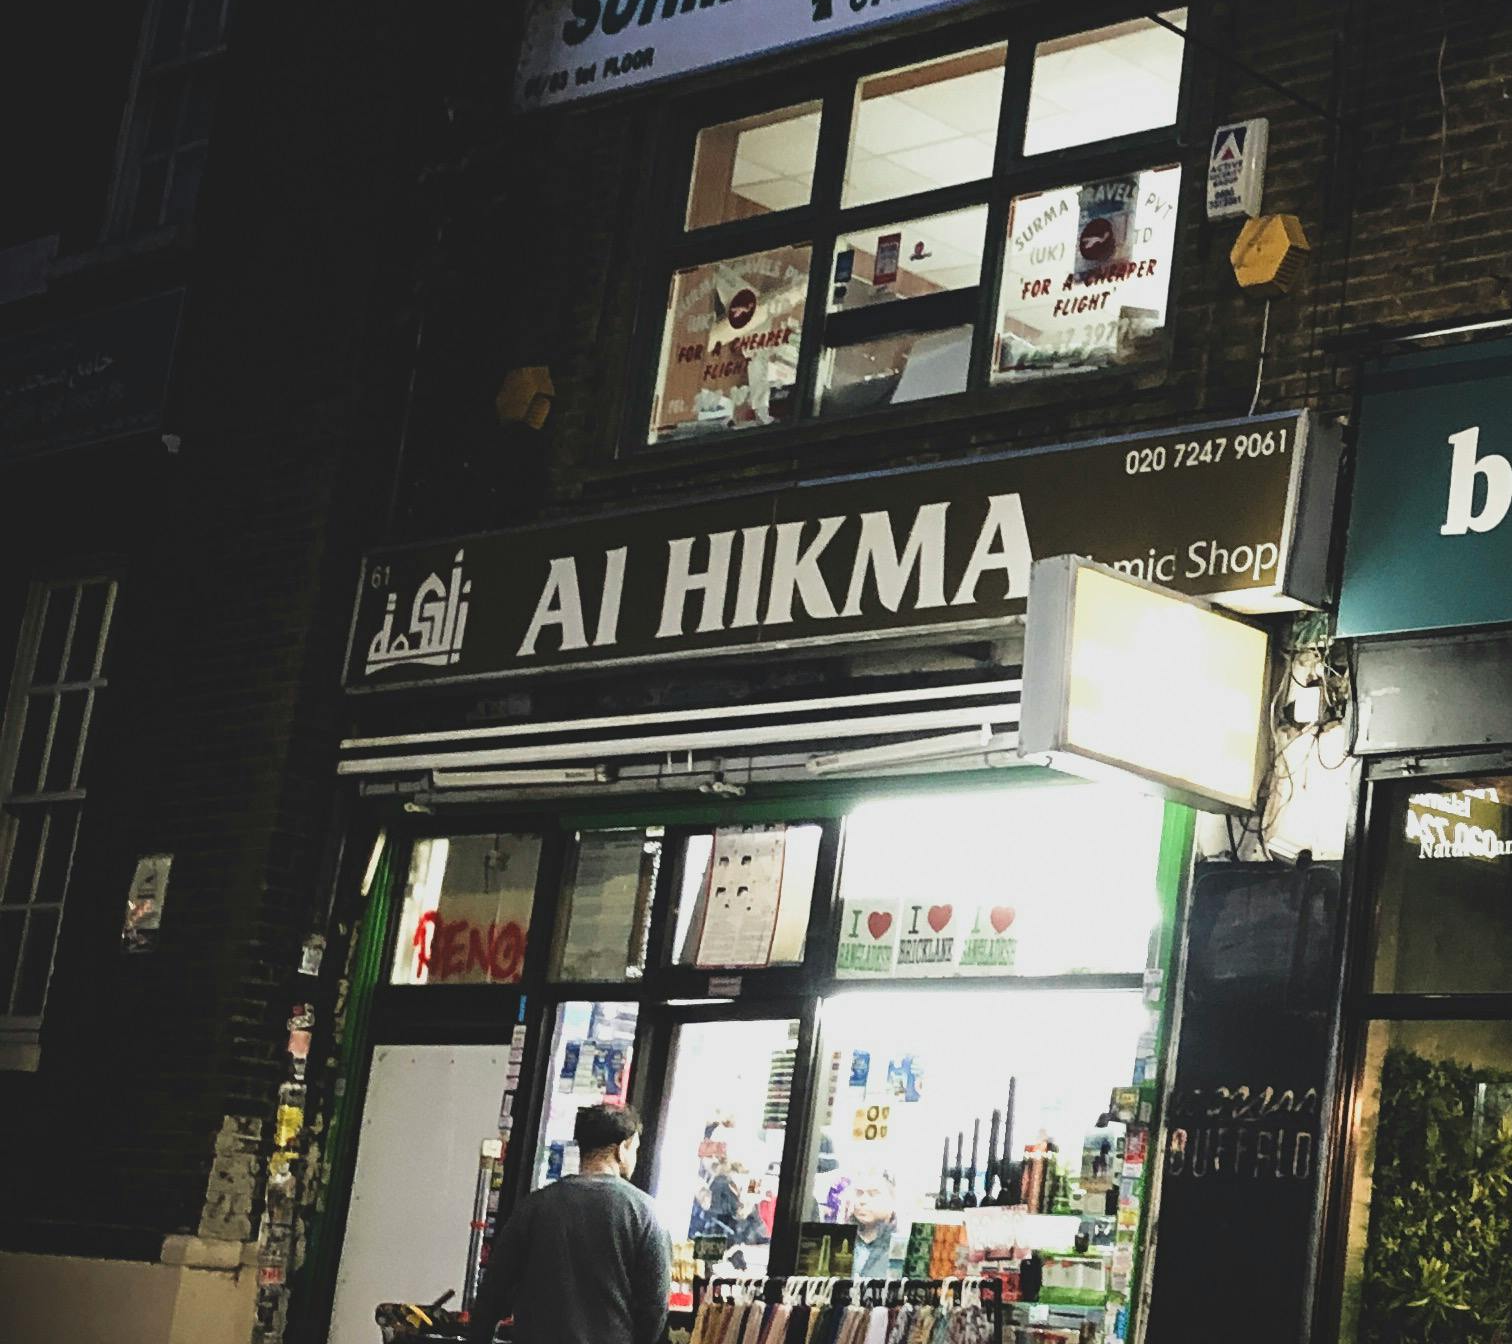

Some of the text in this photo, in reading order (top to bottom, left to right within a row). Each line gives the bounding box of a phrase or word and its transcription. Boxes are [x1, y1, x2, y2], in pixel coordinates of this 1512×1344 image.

[1015, 193, 1173, 252] SURMA PVT
[1030, 243, 1065, 266] (UK)
[1062, 273, 1076, 292] A
[1085, 259, 1158, 288] CHEAPER
[712, 341, 722, 357] A
[730, 327, 792, 353] CHEAPER
[1126, 429, 1287, 475] 020 7247 9061
[655, 492, 1034, 638] HIKMA
[1185, 540, 1278, 580] Shop
[371, 566, 391, 589] 61
[848, 910, 863, 939] I
[908, 906, 923, 935] I
[897, 937, 954, 965] BRICKLANE
